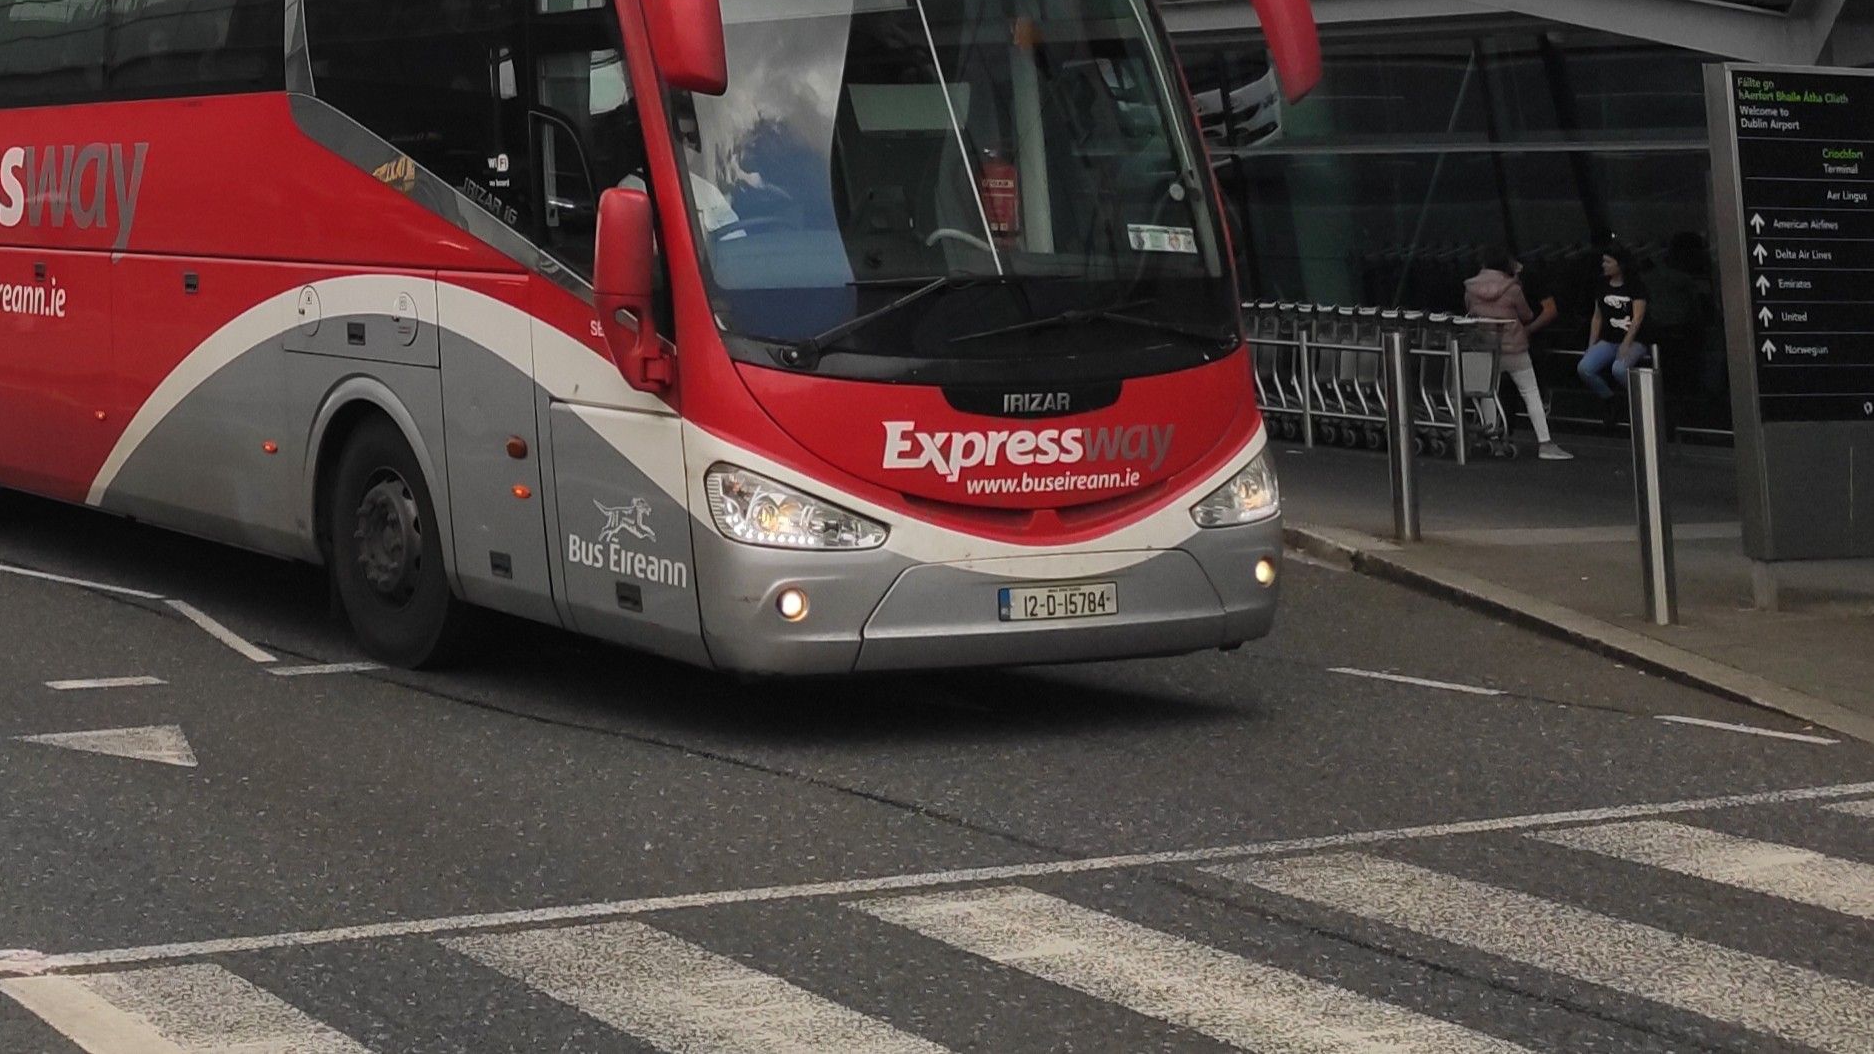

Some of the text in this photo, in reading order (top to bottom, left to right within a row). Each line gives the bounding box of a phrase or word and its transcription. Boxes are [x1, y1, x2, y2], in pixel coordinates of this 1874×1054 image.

[1739, 106, 1789, 117] Welcome to
[1741, 118, 1800, 132] Dublin Airport
[1823, 163, 1859, 174] Terminal
[1827, 190, 1868, 203] Aer Lingus
[1773, 218, 1839, 230] American Airlines
[1776, 248, 1832, 261] Delta Air Lines
[1778, 278, 1812, 289] Emirates
[1781, 311, 1808, 322] United
[1785, 344, 1829, 357] Norwegian
[1003, 392, 1071, 413] IRIZAR
[881, 420, 1176, 483] Expressway
[965, 467, 1141, 495] www.buseireann.ie
[568, 533, 688, 589] Bus Éireann
[1024, 590, 1106, 618] 12-D-15784
